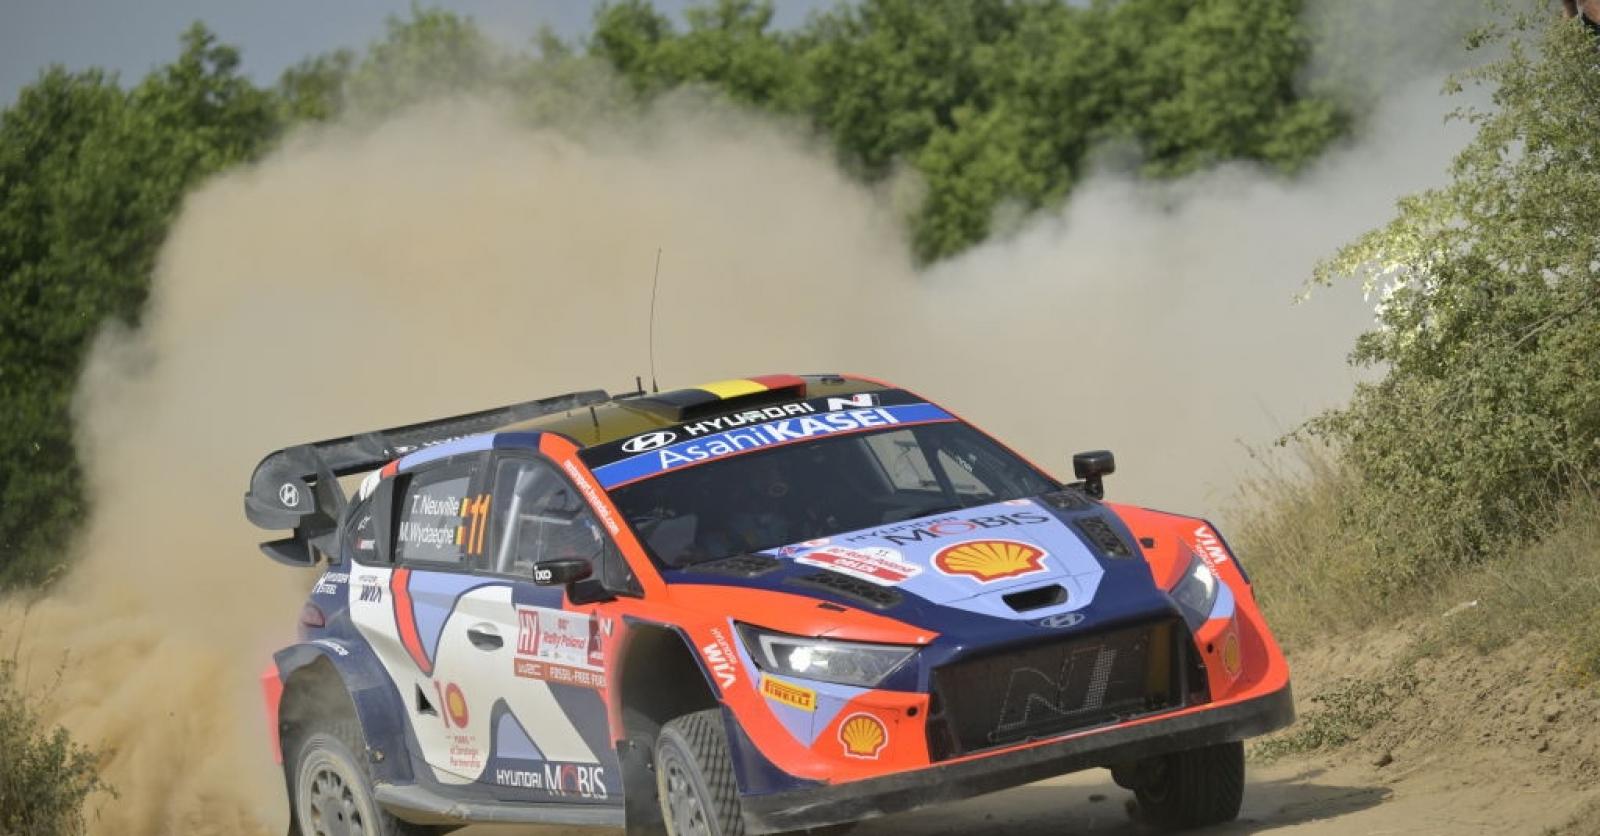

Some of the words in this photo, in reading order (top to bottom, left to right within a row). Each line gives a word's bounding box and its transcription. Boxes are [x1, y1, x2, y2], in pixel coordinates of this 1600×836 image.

[684, 402, 813, 434] HYUNDAI
[423, 493, 460, 517] Neuville
[409, 521, 454, 549] Wydaeghe
[470, 493, 491, 555] 11
[883, 510, 1050, 547] MOBIS
[518, 612, 538, 653] HY
[765, 679, 811, 707] PIRELLI
[496, 769, 542, 788] HYUNDAI
[544, 764, 608, 799] MOBIS
